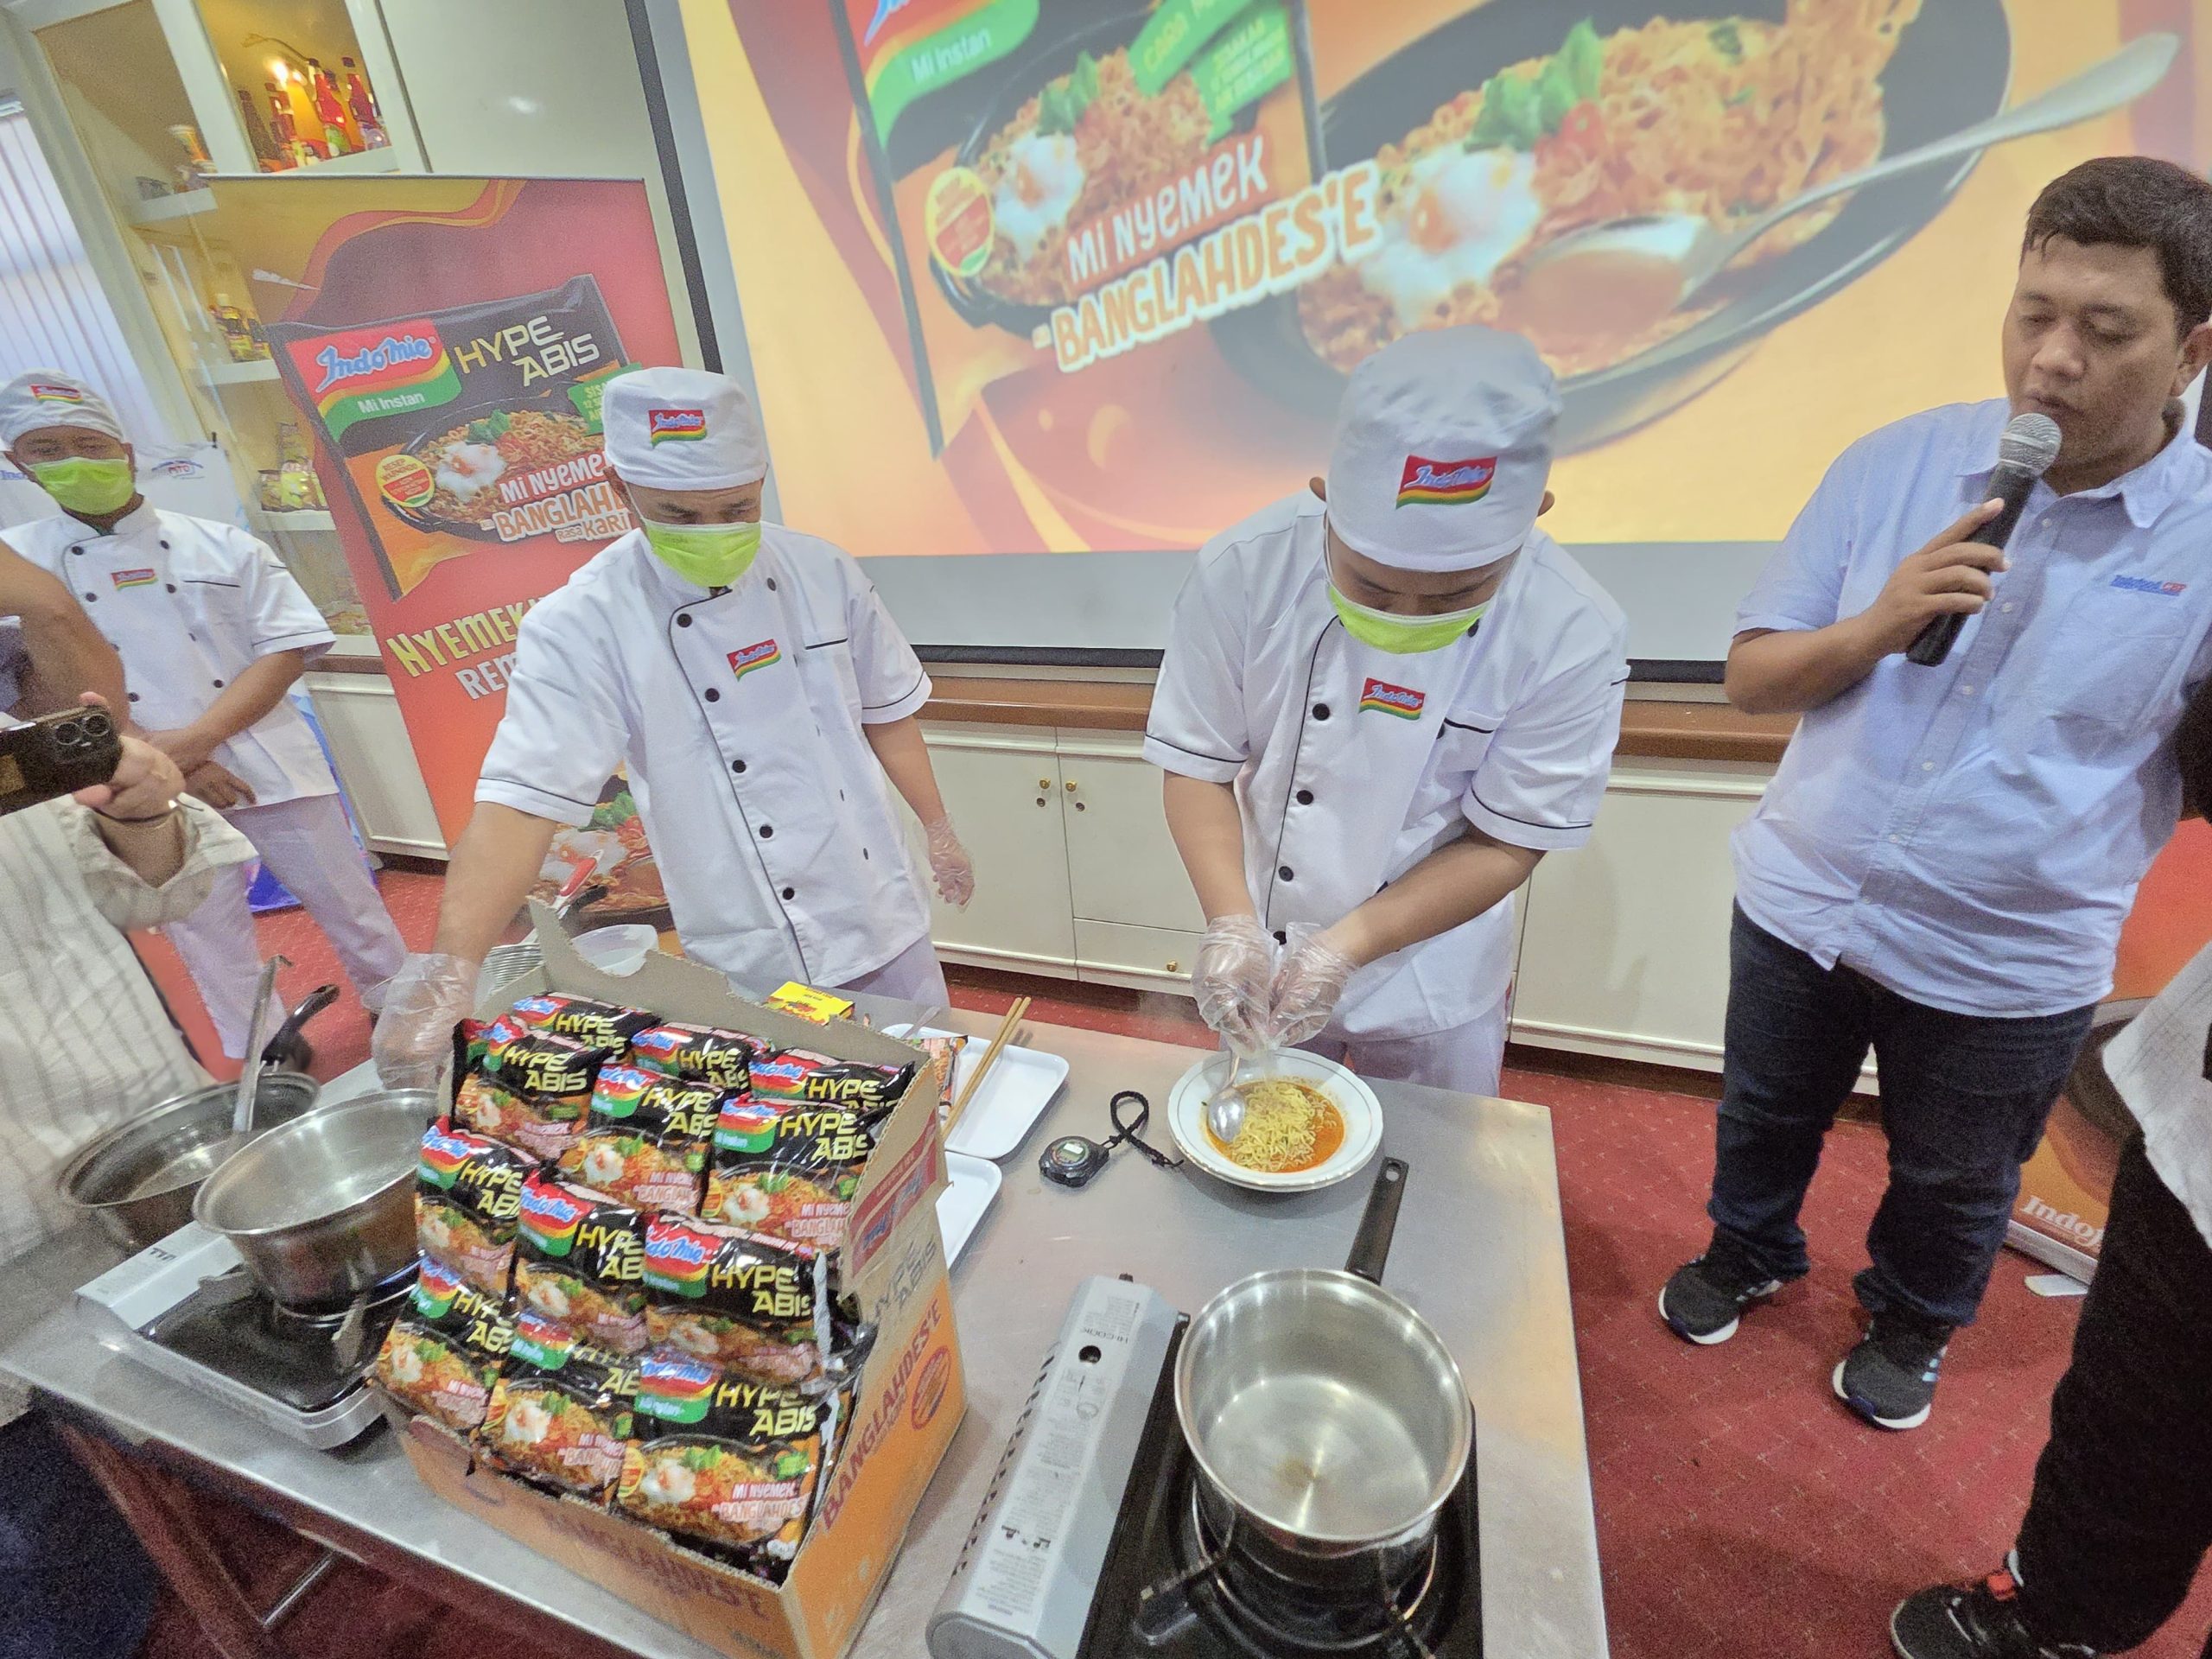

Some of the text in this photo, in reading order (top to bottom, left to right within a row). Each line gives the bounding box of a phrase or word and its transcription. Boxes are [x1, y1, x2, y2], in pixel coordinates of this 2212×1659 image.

[454, 315, 566, 375] HYPE
[512, 332, 601, 387] ABIS
[357, 391, 425, 416] Mi Instan
[386, 598, 540, 677] NYEMEK
[454, 652, 518, 701] REM
[555, 1012, 618, 1036] HYPE
[503, 1045, 574, 1072] HYPE
[678, 1047, 741, 1071] HYPE
[524, 1068, 588, 1093] ABIS
[807, 1077, 885, 1102] HYPE
[779, 1111, 859, 1138] HYPE
[461, 1160, 524, 1194] HYPE
[710, 1263, 799, 1293] HYPE
[752, 1290, 811, 1318] ABIS
[748, 1404, 817, 1437] ABIS
